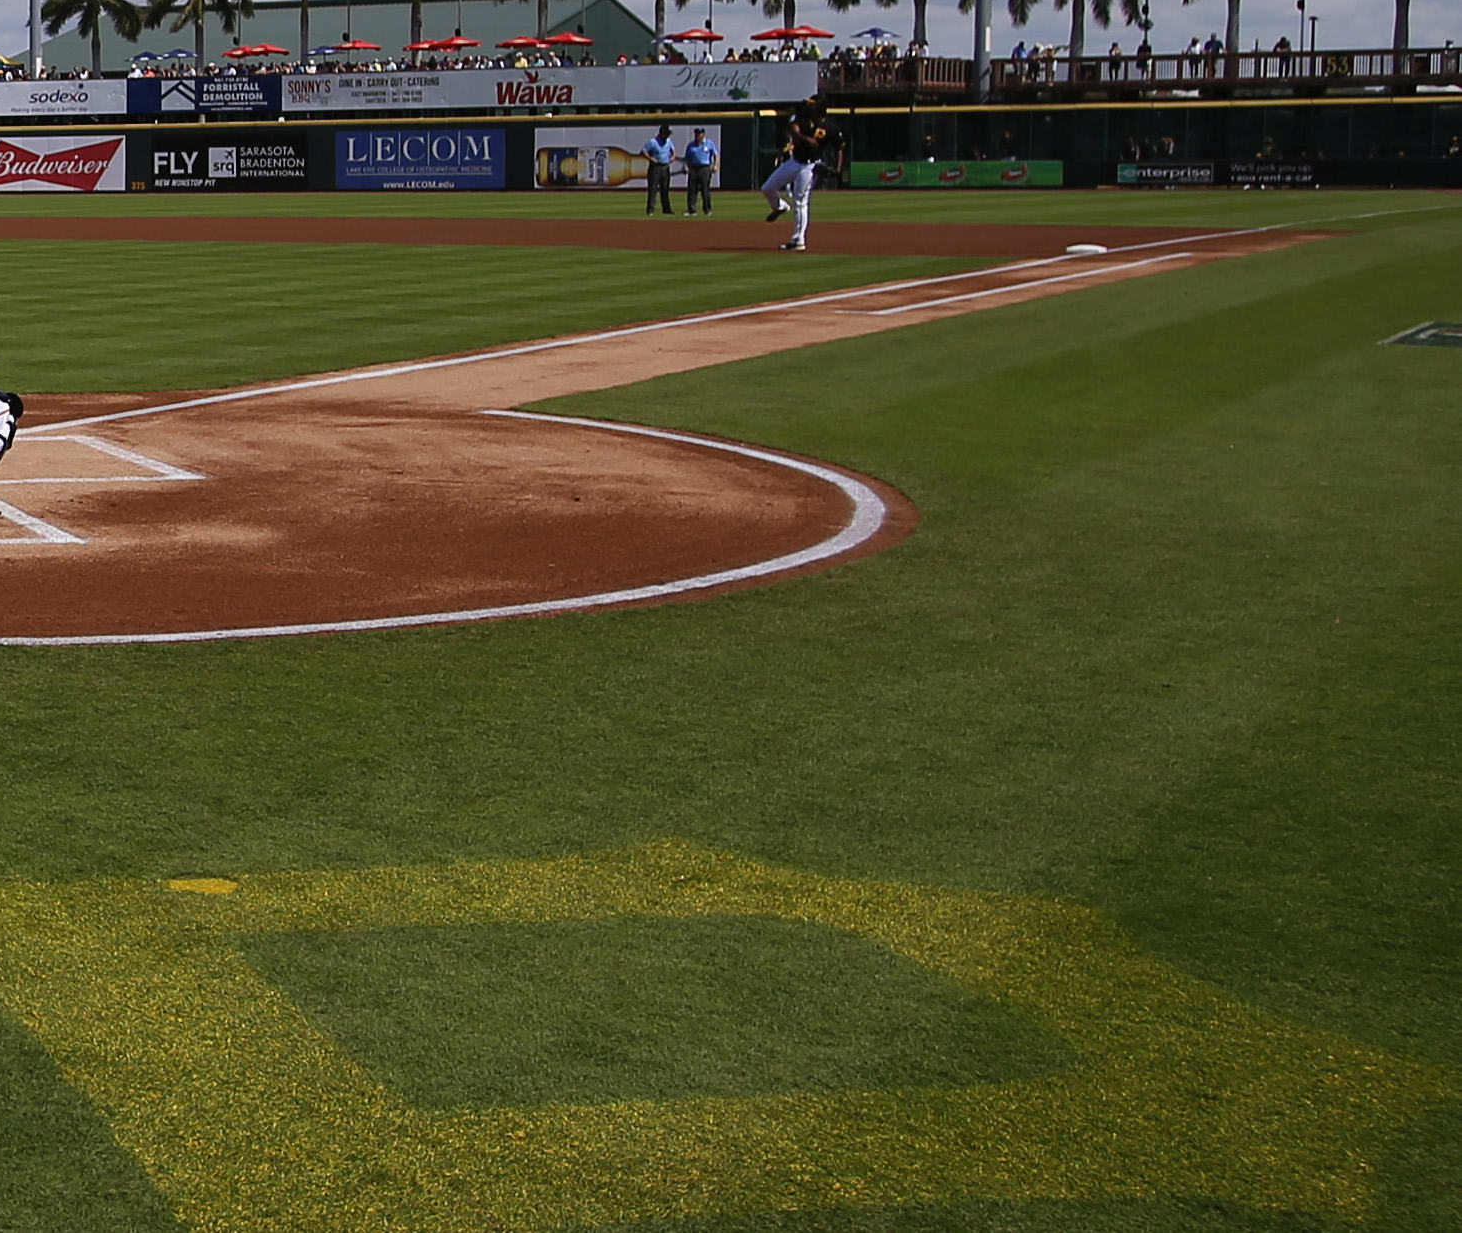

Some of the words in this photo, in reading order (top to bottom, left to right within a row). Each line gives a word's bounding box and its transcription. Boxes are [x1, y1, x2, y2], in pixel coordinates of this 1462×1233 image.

[203, 82, 260, 92] FORRISTALL
[288, 79, 331, 94] SONNY'S
[339, 78, 354, 88] DINE
[355, 78, 363, 87] IN
[367, 77, 389, 87] CARRY
[390, 77, 403, 87] OUT
[407, 76, 440, 87] CATERING
[29, 89, 89, 103] sodexo
[202, 92, 263, 101] DEMOLITION
[291, 93, 311, 104] BBQ
[496, 81, 573, 105] Wawa
[240, 146, 295, 157] SARASOTA
[346, 135, 492, 162] LECOM
[154, 151, 199, 174] FLY
[213, 161, 235, 175] srq
[240, 158, 305, 168] BRADENTON
[377, 166, 404, 174] COLLEGE
[1125, 167, 1211, 179] enterprise
[154, 179, 170, 187] NEW
[171, 178, 203, 187] NONSTOP
[204, 178, 216, 187] PIT
[383, 180, 455, 189] www.LECOM.edu
